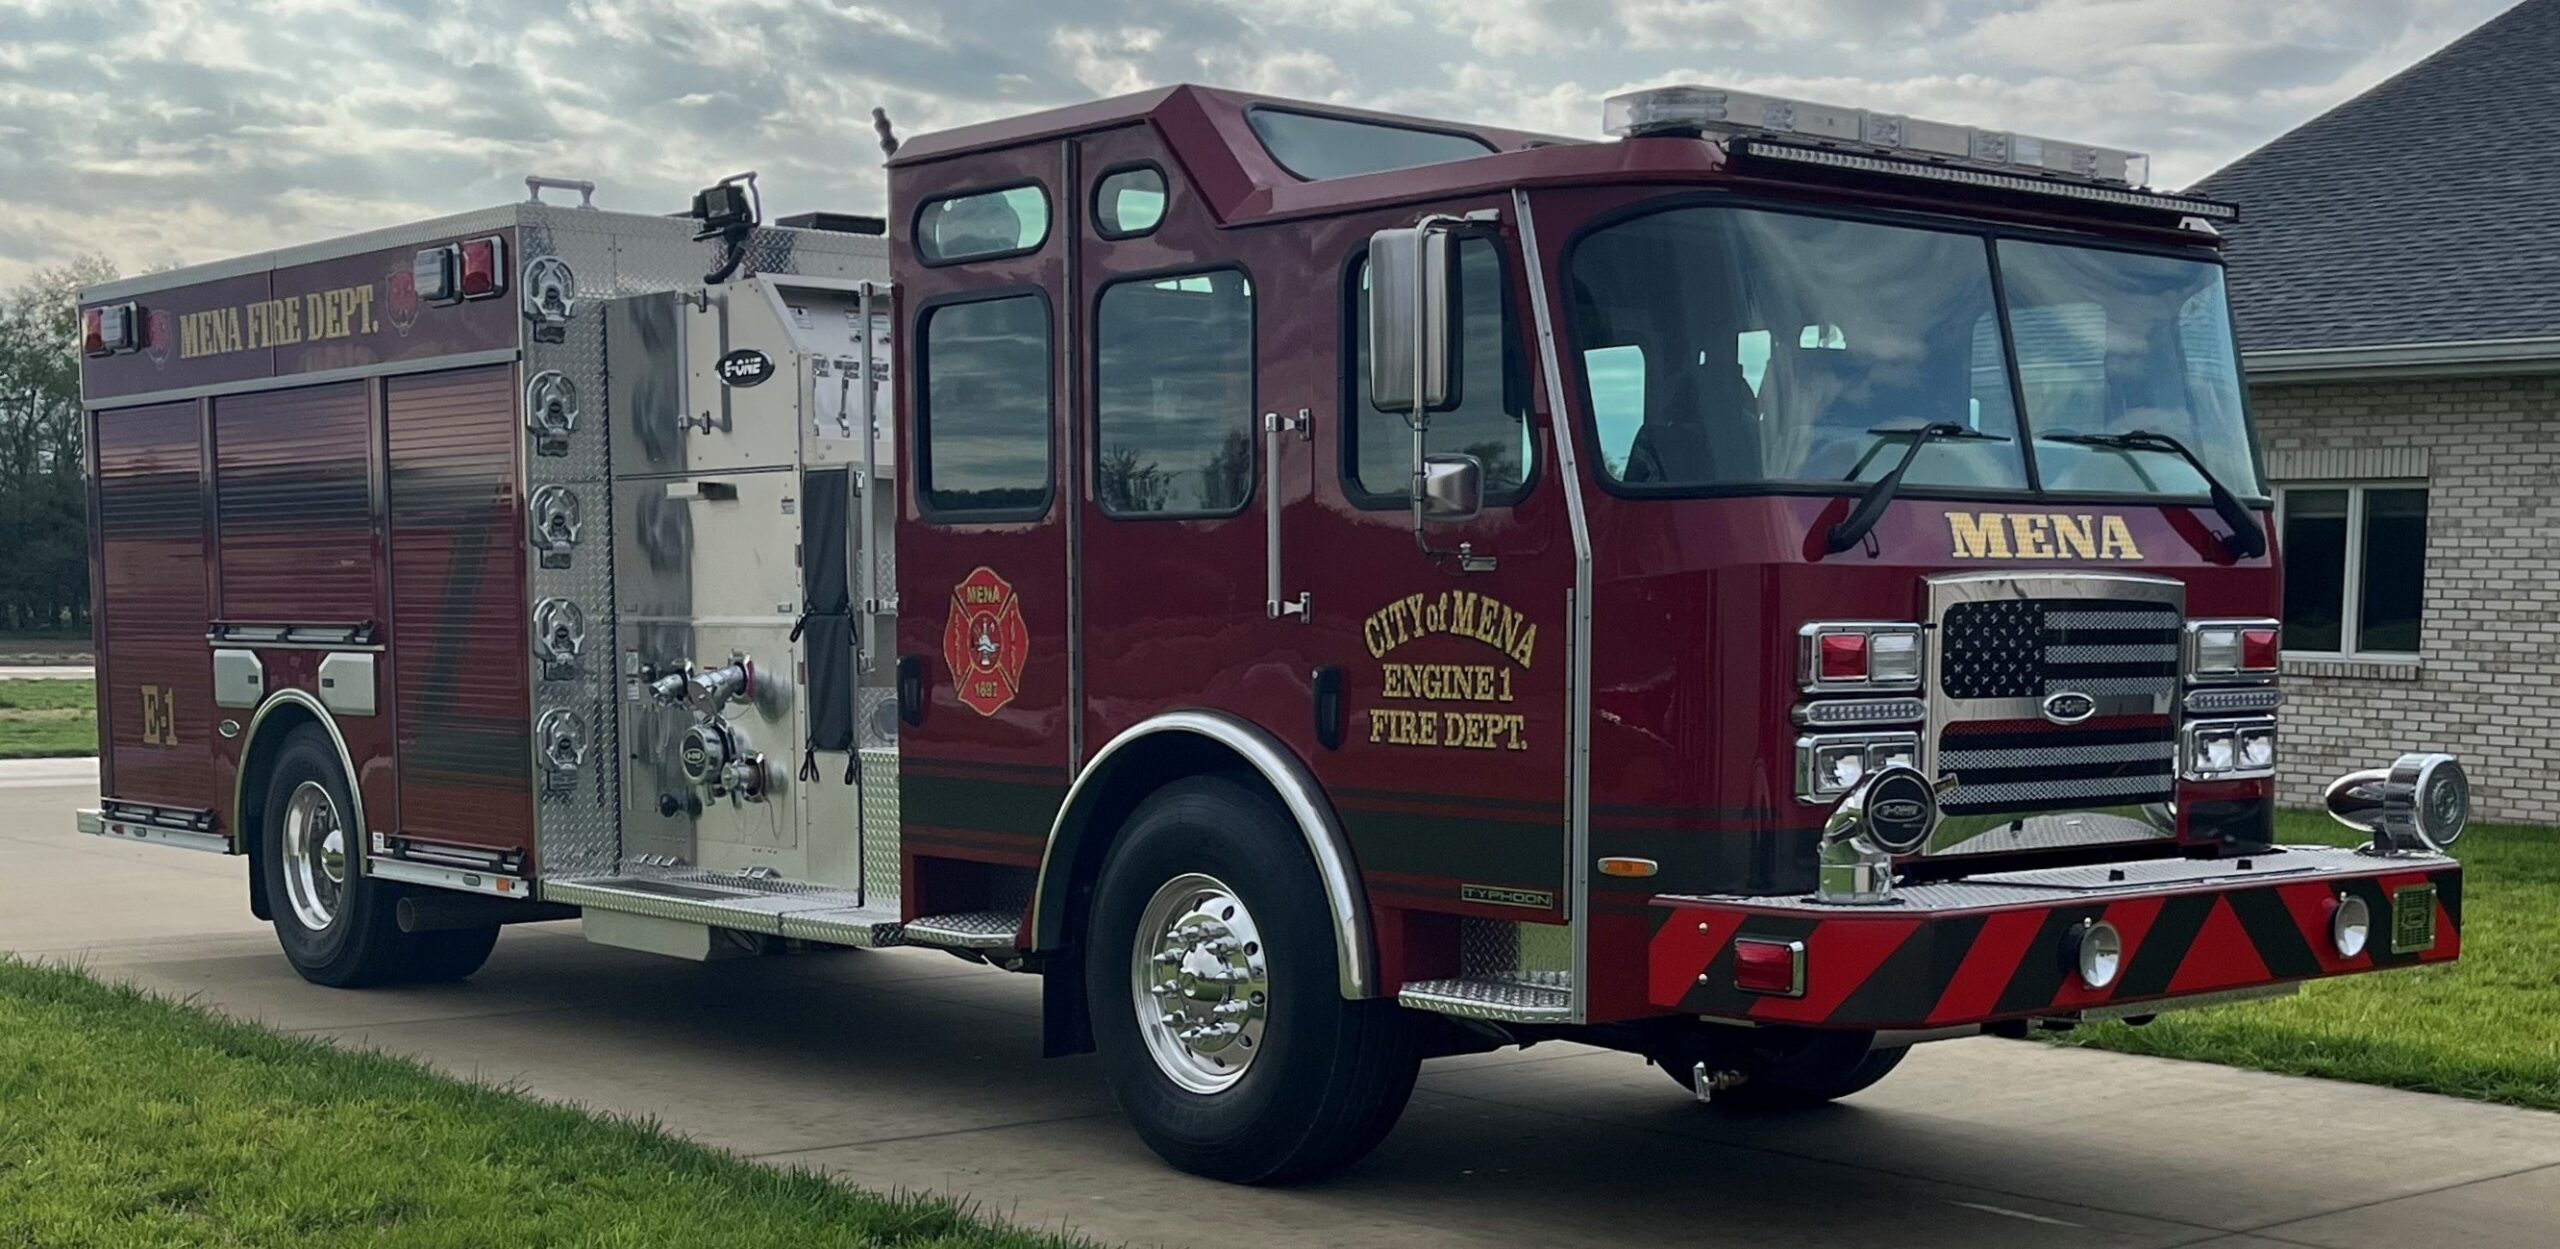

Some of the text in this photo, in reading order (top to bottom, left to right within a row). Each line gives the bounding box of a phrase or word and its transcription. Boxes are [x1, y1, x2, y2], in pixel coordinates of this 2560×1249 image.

[179, 284, 380, 359] MENA FIRE DEPT.
[724, 356, 762, 378] E-ONE
[1944, 511, 2145, 560] MENA
[966, 584, 1001, 604] MENA
[1364, 589, 1537, 670] CITY of MENA
[1382, 663, 1514, 701] ENGINE 1
[141, 684, 178, 747] E-1
[1369, 708, 1528, 751] FIRE DEPT.
[1463, 887, 1551, 905] TYPHOON
